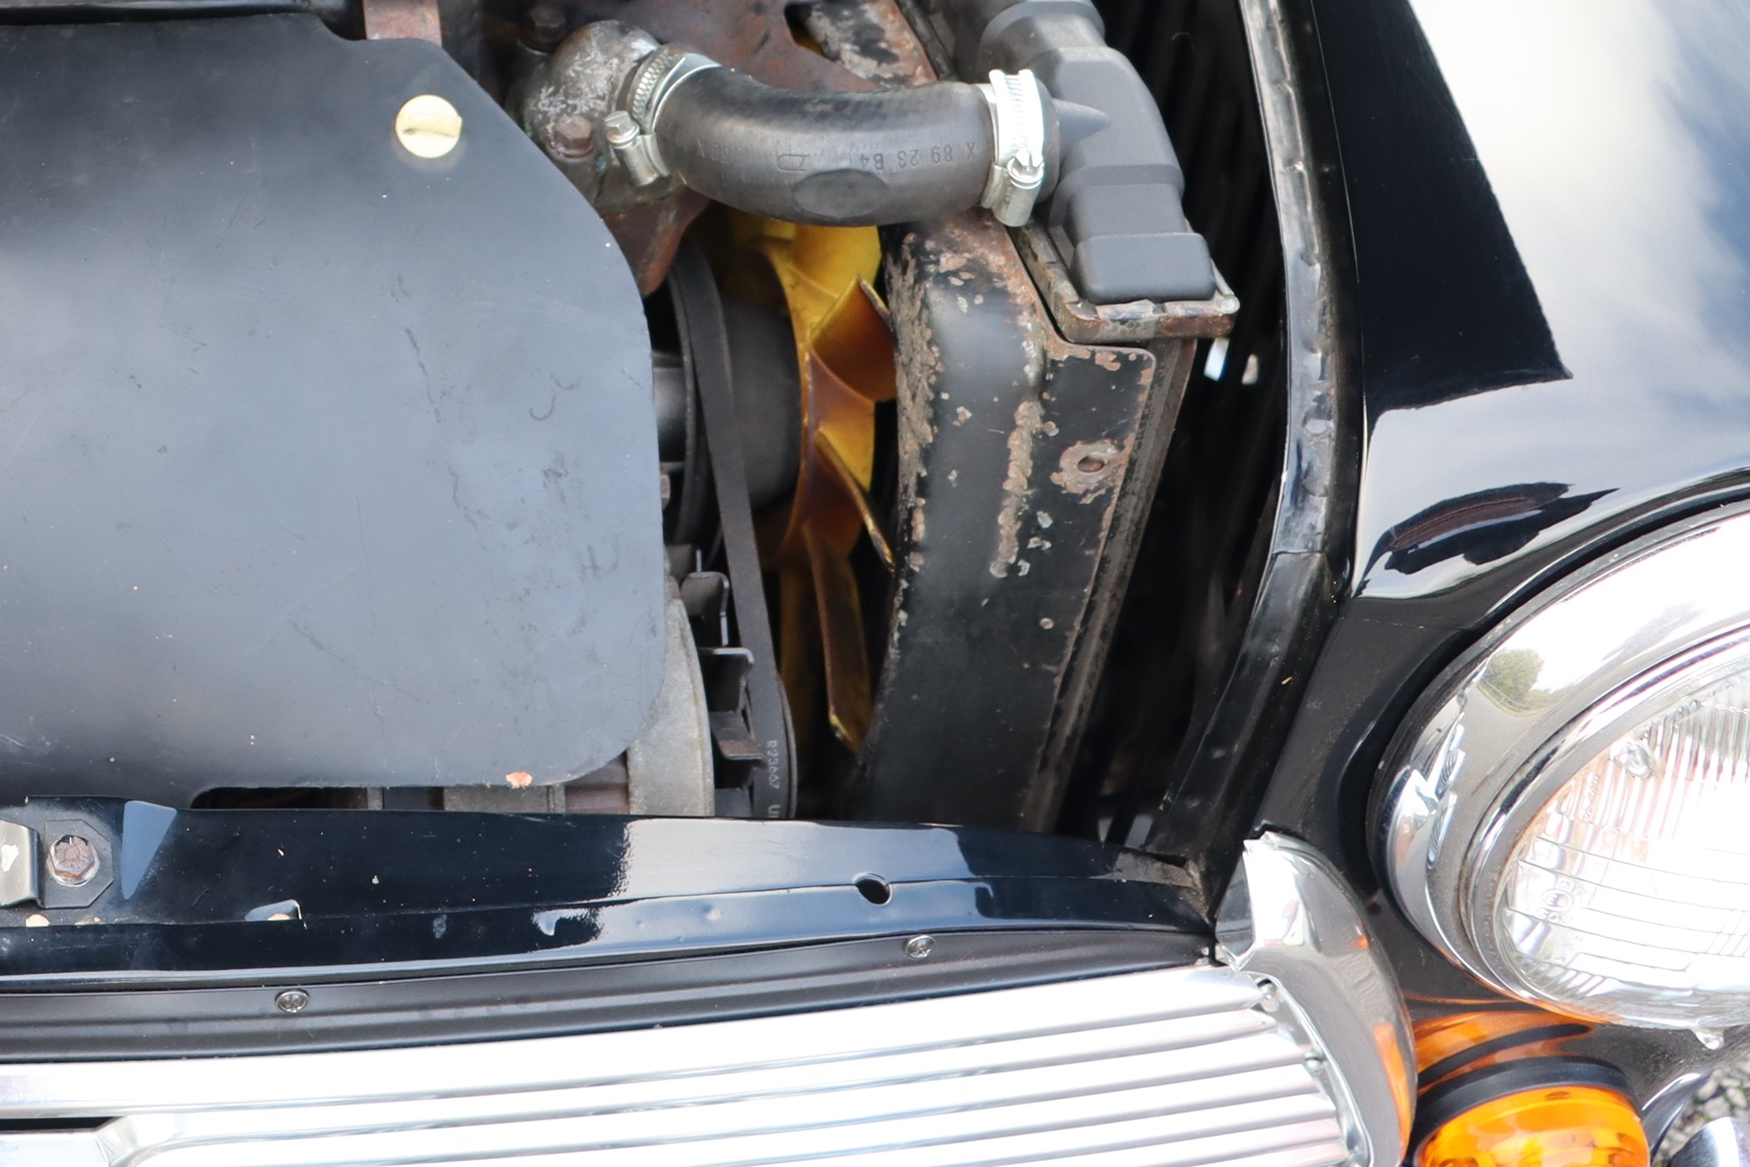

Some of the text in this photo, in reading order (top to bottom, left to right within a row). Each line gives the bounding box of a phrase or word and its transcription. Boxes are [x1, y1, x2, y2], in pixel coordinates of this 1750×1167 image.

[858, 153, 885, 171] B4
[896, 148, 920, 169] 23
[930, 144, 954, 164] 89
